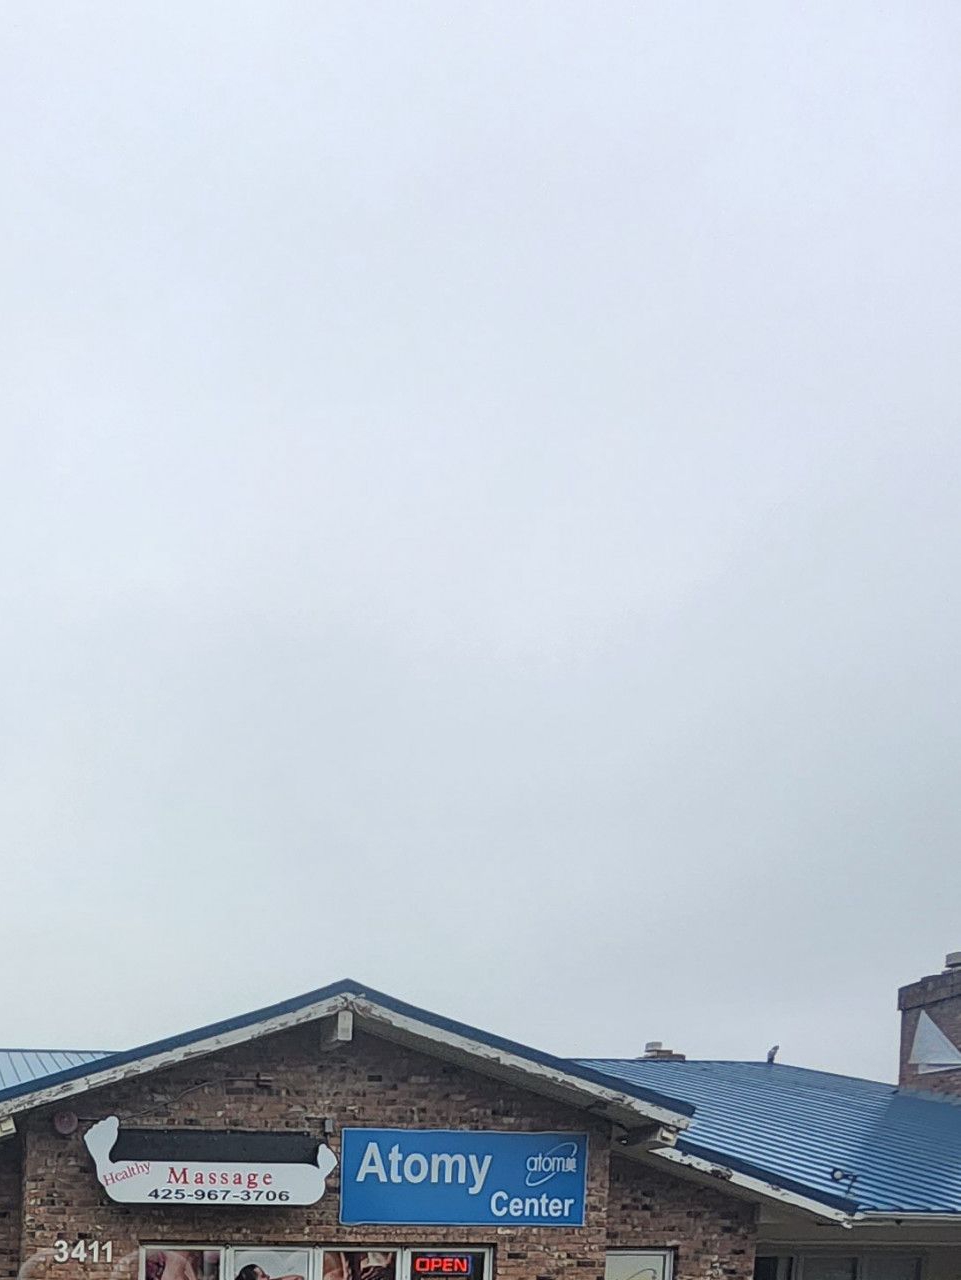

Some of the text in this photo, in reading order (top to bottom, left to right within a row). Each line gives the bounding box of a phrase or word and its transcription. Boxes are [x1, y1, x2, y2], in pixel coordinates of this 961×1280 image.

[102, 1160, 273, 1188] Healthy Massage
[356, 1142, 492, 1195] Atomy
[147, 1188, 290, 1201] 425-967-3706
[490, 1191, 575, 1217] Center
[53, 1240, 113, 1263] 3411
[415, 1257, 467, 1271] OPEN
